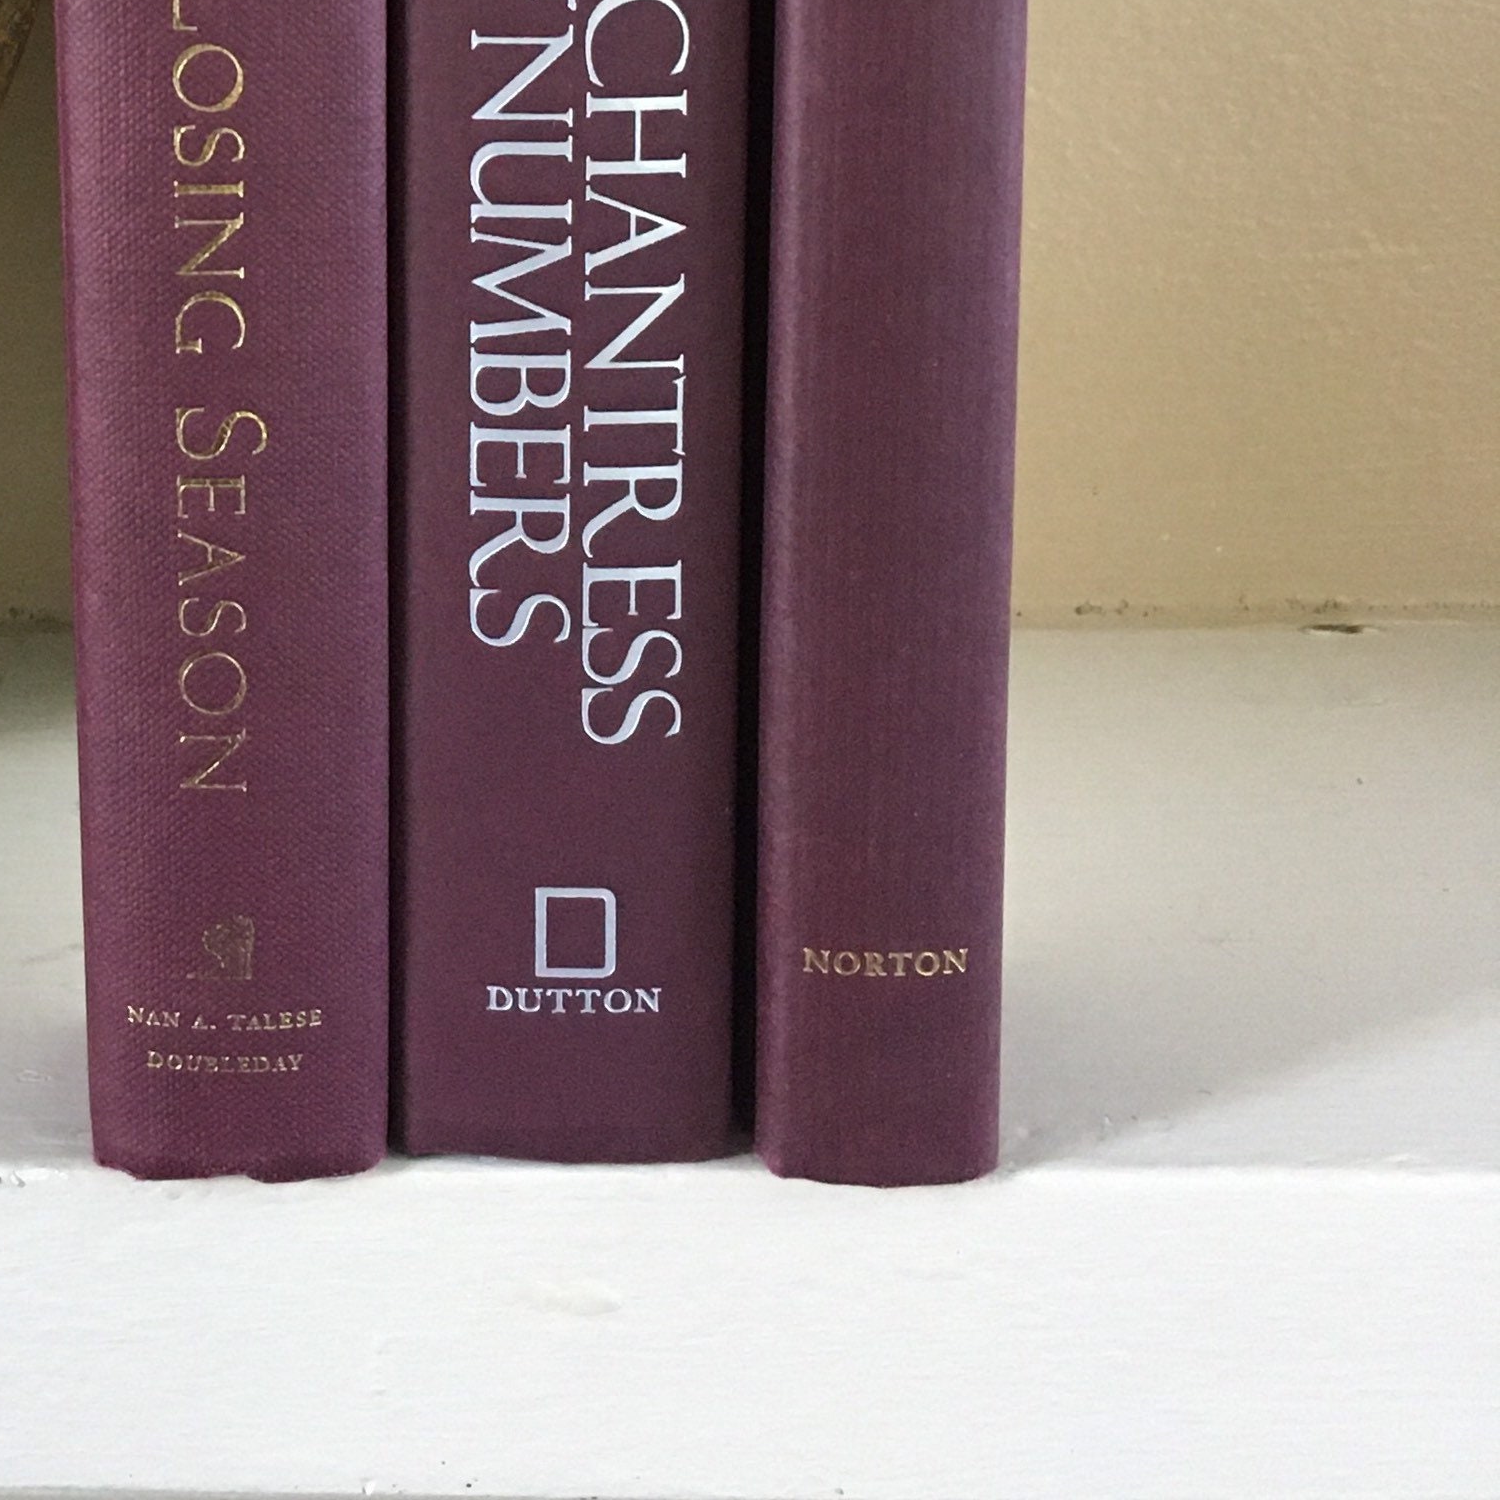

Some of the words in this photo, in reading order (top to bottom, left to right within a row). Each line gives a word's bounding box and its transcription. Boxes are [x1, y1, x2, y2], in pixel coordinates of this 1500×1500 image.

[467, 24, 575, 649] NUMBERS
[175, 405, 268, 794] SEASON
[802, 946, 969, 977] NORTON
[486, 984, 662, 1015] DUTTON
[126, 1005, 182, 1029] NAN
[190, 1013, 218, 1031] A.
[226, 1008, 324, 1031] TALESE
[146, 1050, 304, 1073] DOUBLEDAY
